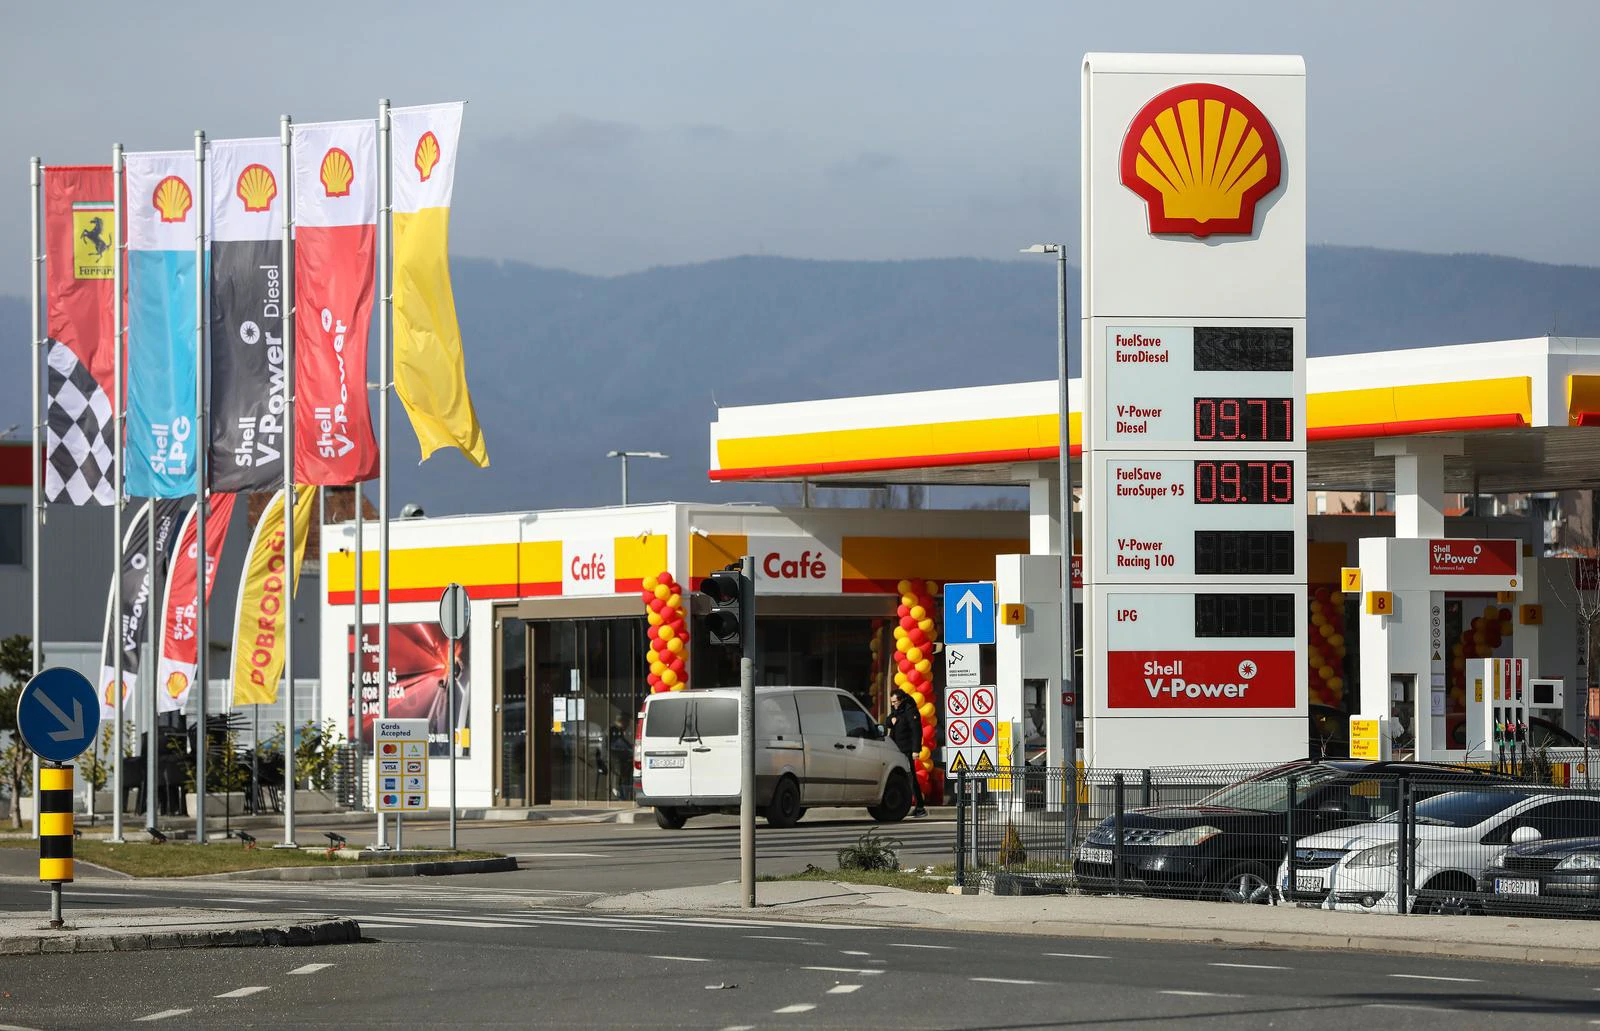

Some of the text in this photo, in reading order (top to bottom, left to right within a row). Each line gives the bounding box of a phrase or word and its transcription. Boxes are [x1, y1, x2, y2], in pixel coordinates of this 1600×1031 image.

[260, 265, 280, 318] Diesel
[1116, 334, 1161, 347] FuelSave
[1116, 350, 1169, 363] EuroDiesel
[334, 319, 355, 457] V-Power
[255, 332, 284, 467] V-Power
[1116, 405, 1162, 418] V-Power
[1116, 421, 1147, 434] Diesel
[1195, 400, 1291, 440] 09.71
[315, 407, 335, 458] Shell
[167, 415, 191, 475] LPG
[235, 416, 257, 467] Shell
[150, 423, 169, 477] Shell
[1116, 468, 1162, 481] FuelSave
[1195, 463, 1292, 503] 09.79
[1116, 484, 1185, 499] EuroSuper 95
[1117, 539, 1163, 551] V-Power
[1433, 544, 1451, 553] Shell
[763, 550, 827, 579] Café
[1117, 554, 1175, 570] Racing 100
[1433, 553, 1478, 564] V-Power
[571, 553, 606, 581] Café
[1348, 573, 1357, 586] 7
[1378, 597, 1386, 610] 8
[1011, 609, 1020, 621] 4
[1117, 609, 1138, 622] LPG
[1529, 609, 1537, 619] 2
[1143, 660, 1183, 676] Shell
[1144, 678, 1249, 698] V-Power
[381, 730, 411, 738] Accepted
